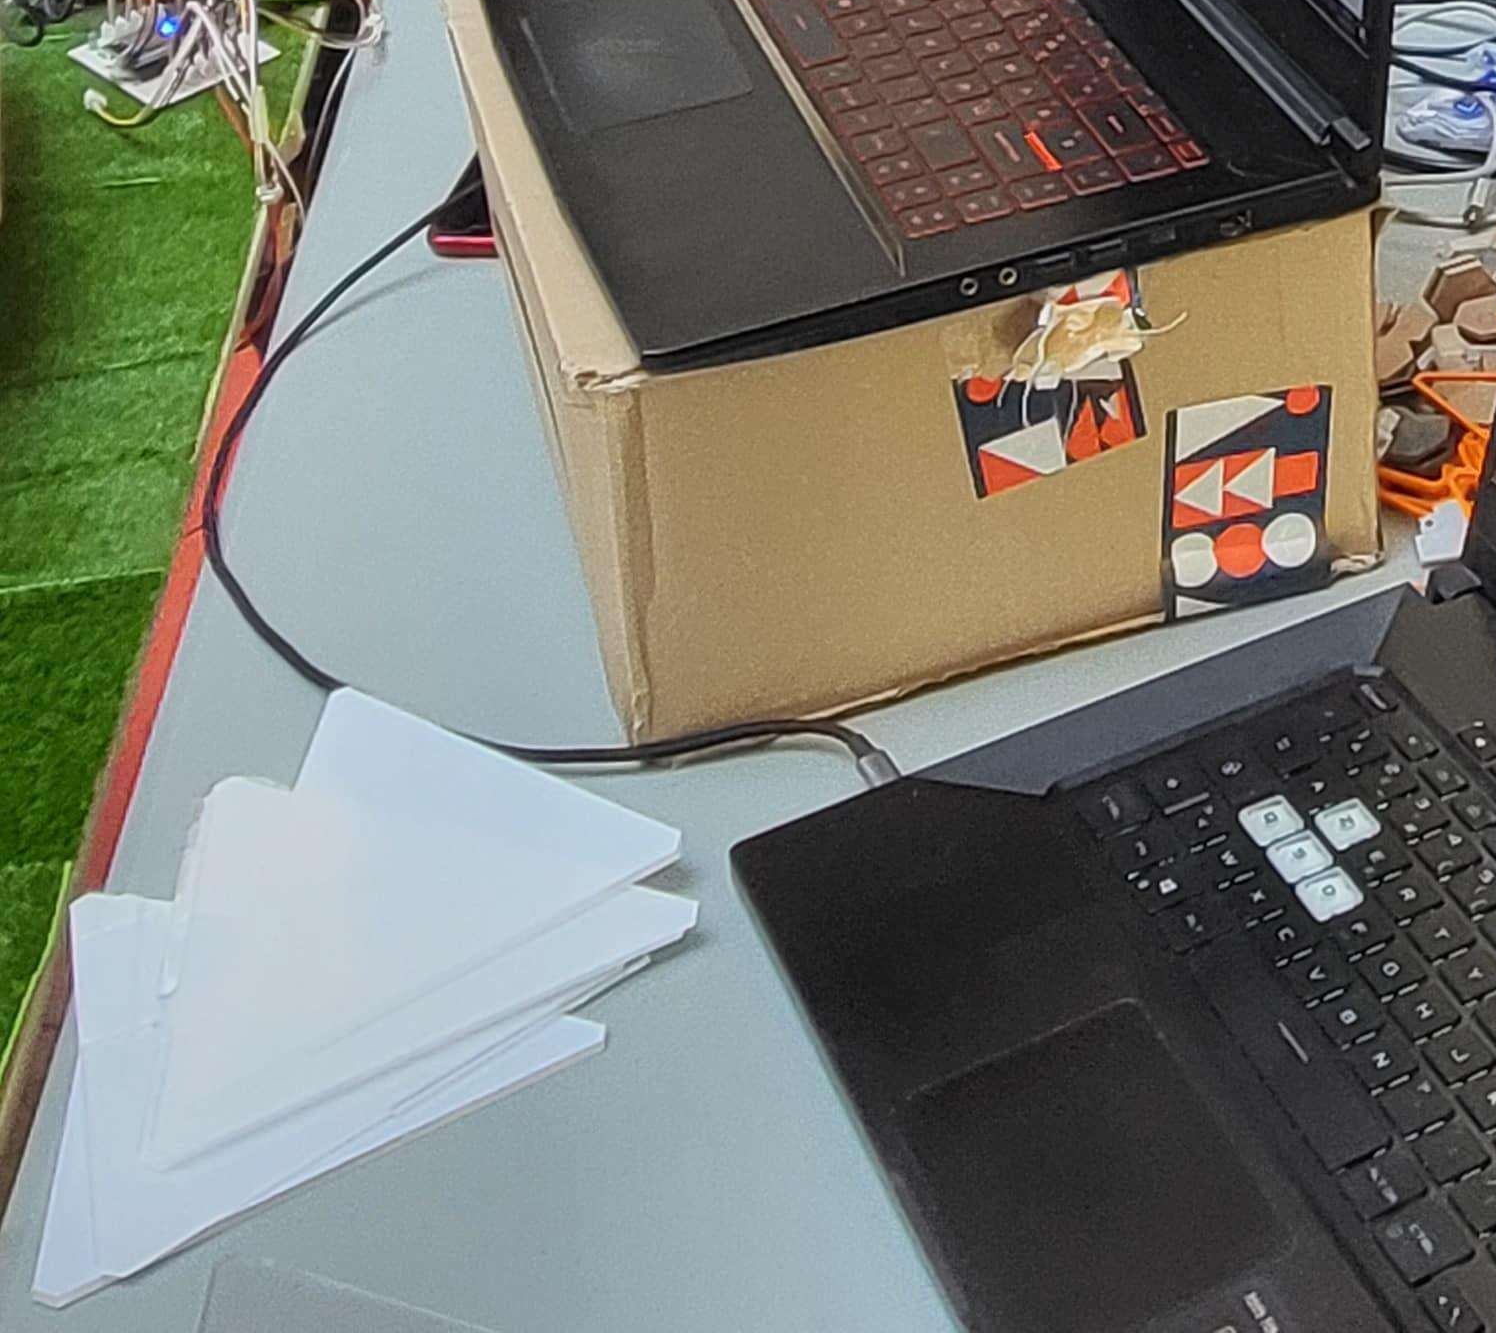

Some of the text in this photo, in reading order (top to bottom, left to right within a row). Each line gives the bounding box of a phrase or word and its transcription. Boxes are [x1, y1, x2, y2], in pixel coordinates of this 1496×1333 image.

[1220, 850, 1239, 867] W
[1278, 927, 1295, 942] C
[1309, 965, 1326, 981] V
[1372, 1051, 1391, 1069] N
[1400, 887, 1416, 901] R
[1468, 967, 1484, 980] Y
[1415, 1003, 1434, 1020] H
[1450, 1049, 1470, 1062] J
